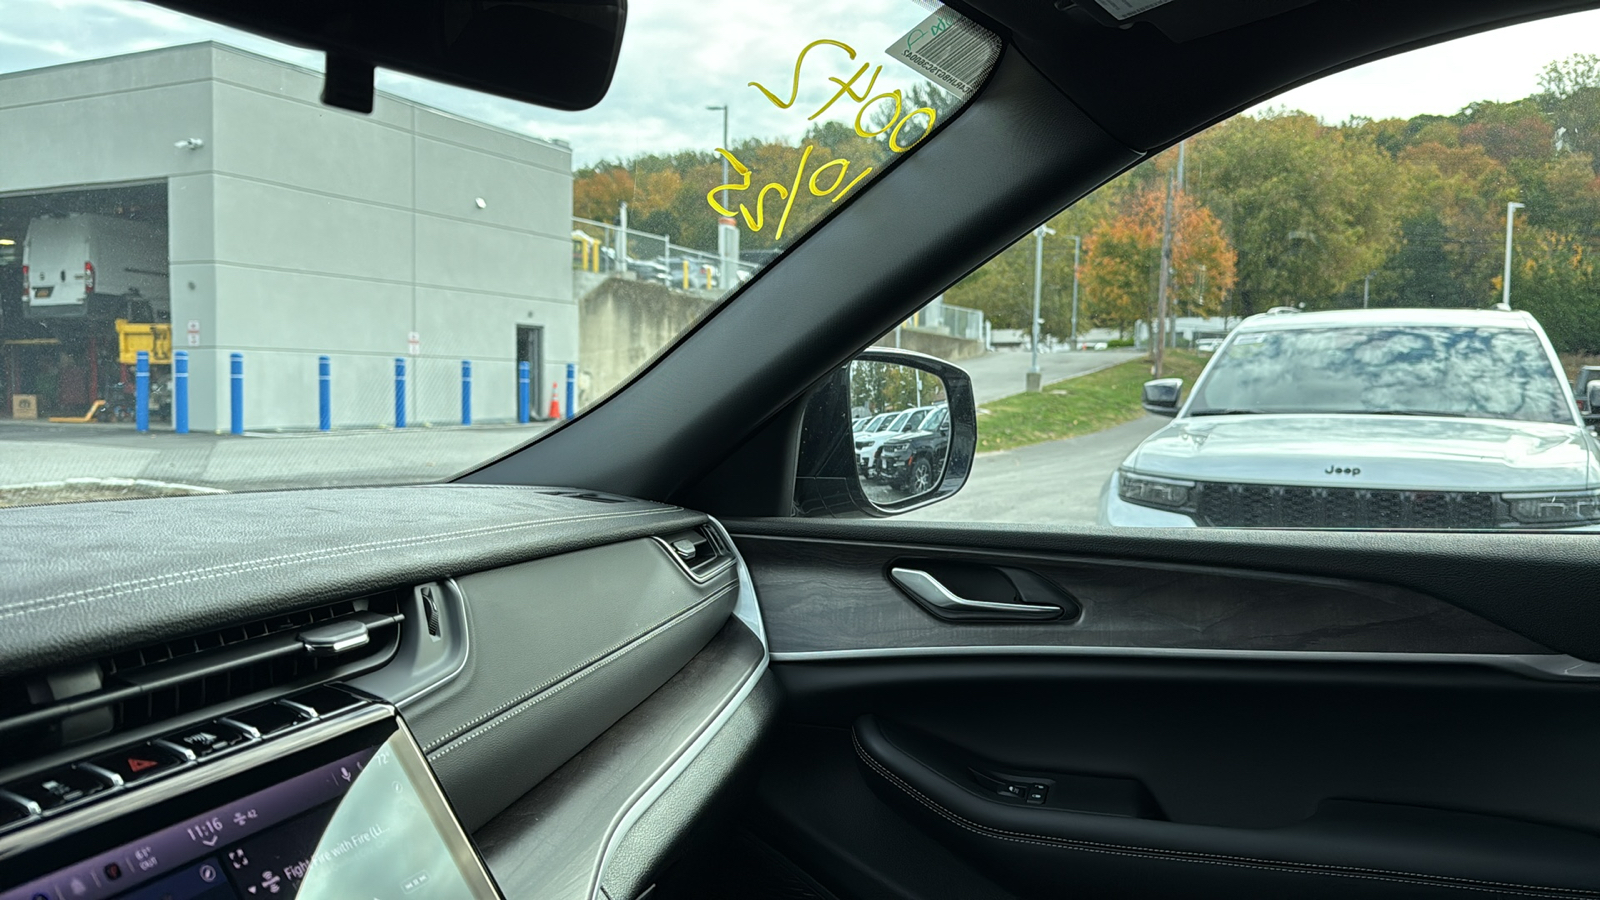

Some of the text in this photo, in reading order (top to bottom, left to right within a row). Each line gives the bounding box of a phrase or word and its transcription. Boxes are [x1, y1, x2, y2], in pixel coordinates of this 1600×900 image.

[1324, 464, 1361, 477] Jeep
[247, 808, 258, 819] 42
[187, 816, 223, 841] 11:16
[330, 840, 352, 858] with
[351, 832, 371, 847] Fire
